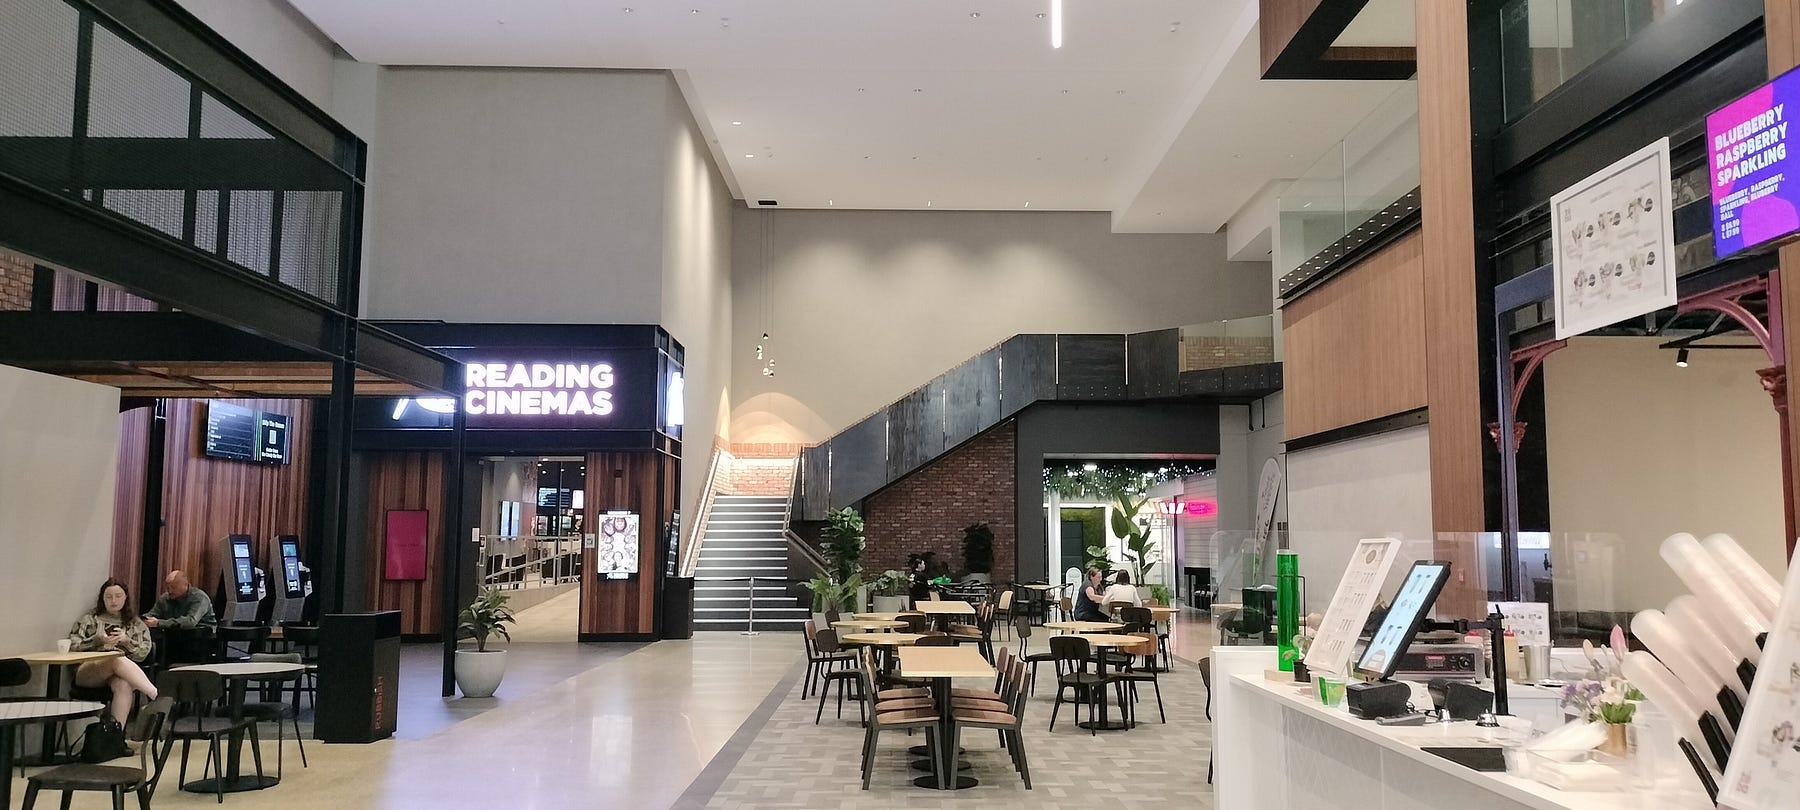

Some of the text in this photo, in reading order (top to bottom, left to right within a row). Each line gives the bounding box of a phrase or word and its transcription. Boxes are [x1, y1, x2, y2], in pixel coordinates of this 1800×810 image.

[1715, 103, 1784, 152] BLUEBERRY
[1716, 121, 1788, 169] RASPBERRY
[1717, 142, 1787, 187] SPARKLING
[466, 363, 614, 388] READING
[465, 390, 613, 415] CINEMAS
